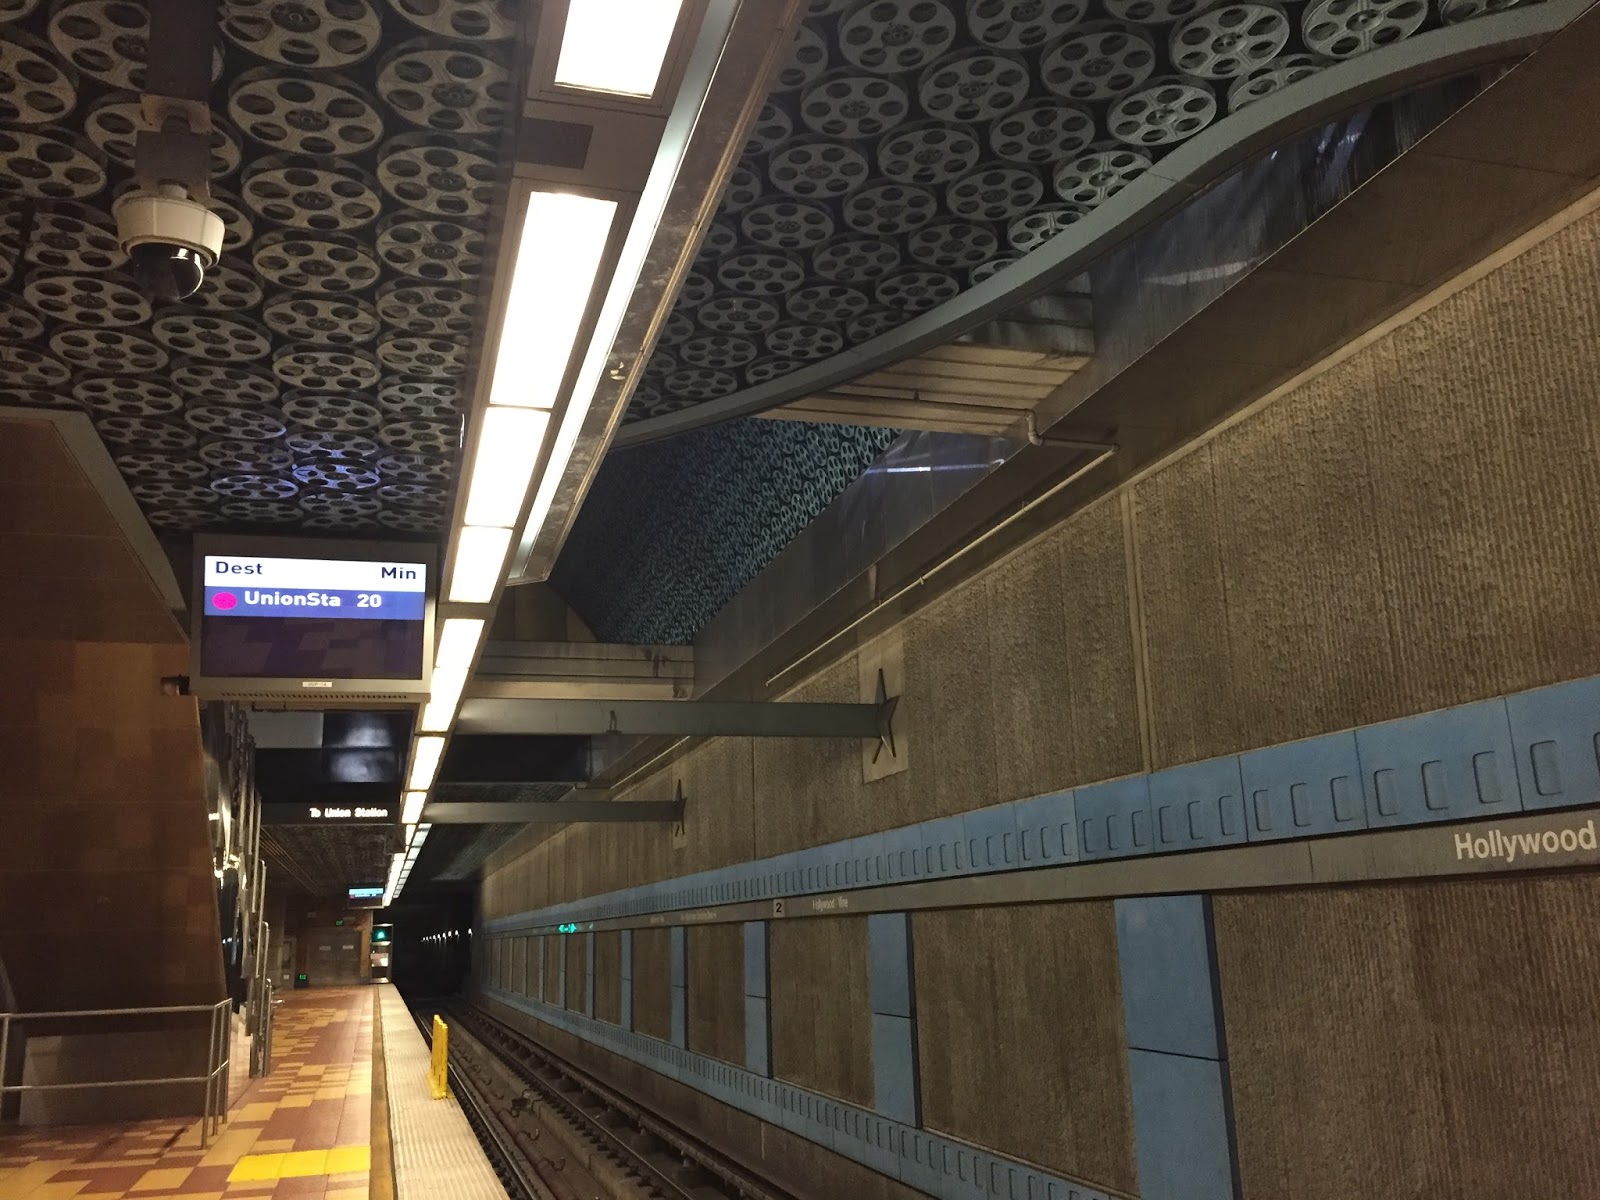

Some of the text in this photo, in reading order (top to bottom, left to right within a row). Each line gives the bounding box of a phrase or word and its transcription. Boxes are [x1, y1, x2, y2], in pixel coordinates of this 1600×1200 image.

[215, 561, 417, 580] Dest Min
[244, 590, 382, 608] UnionSta 20
[309, 807, 388, 818] To Union Station
[1454, 820, 1597, 863] Hollywood
[775, 902, 783, 913] 2
